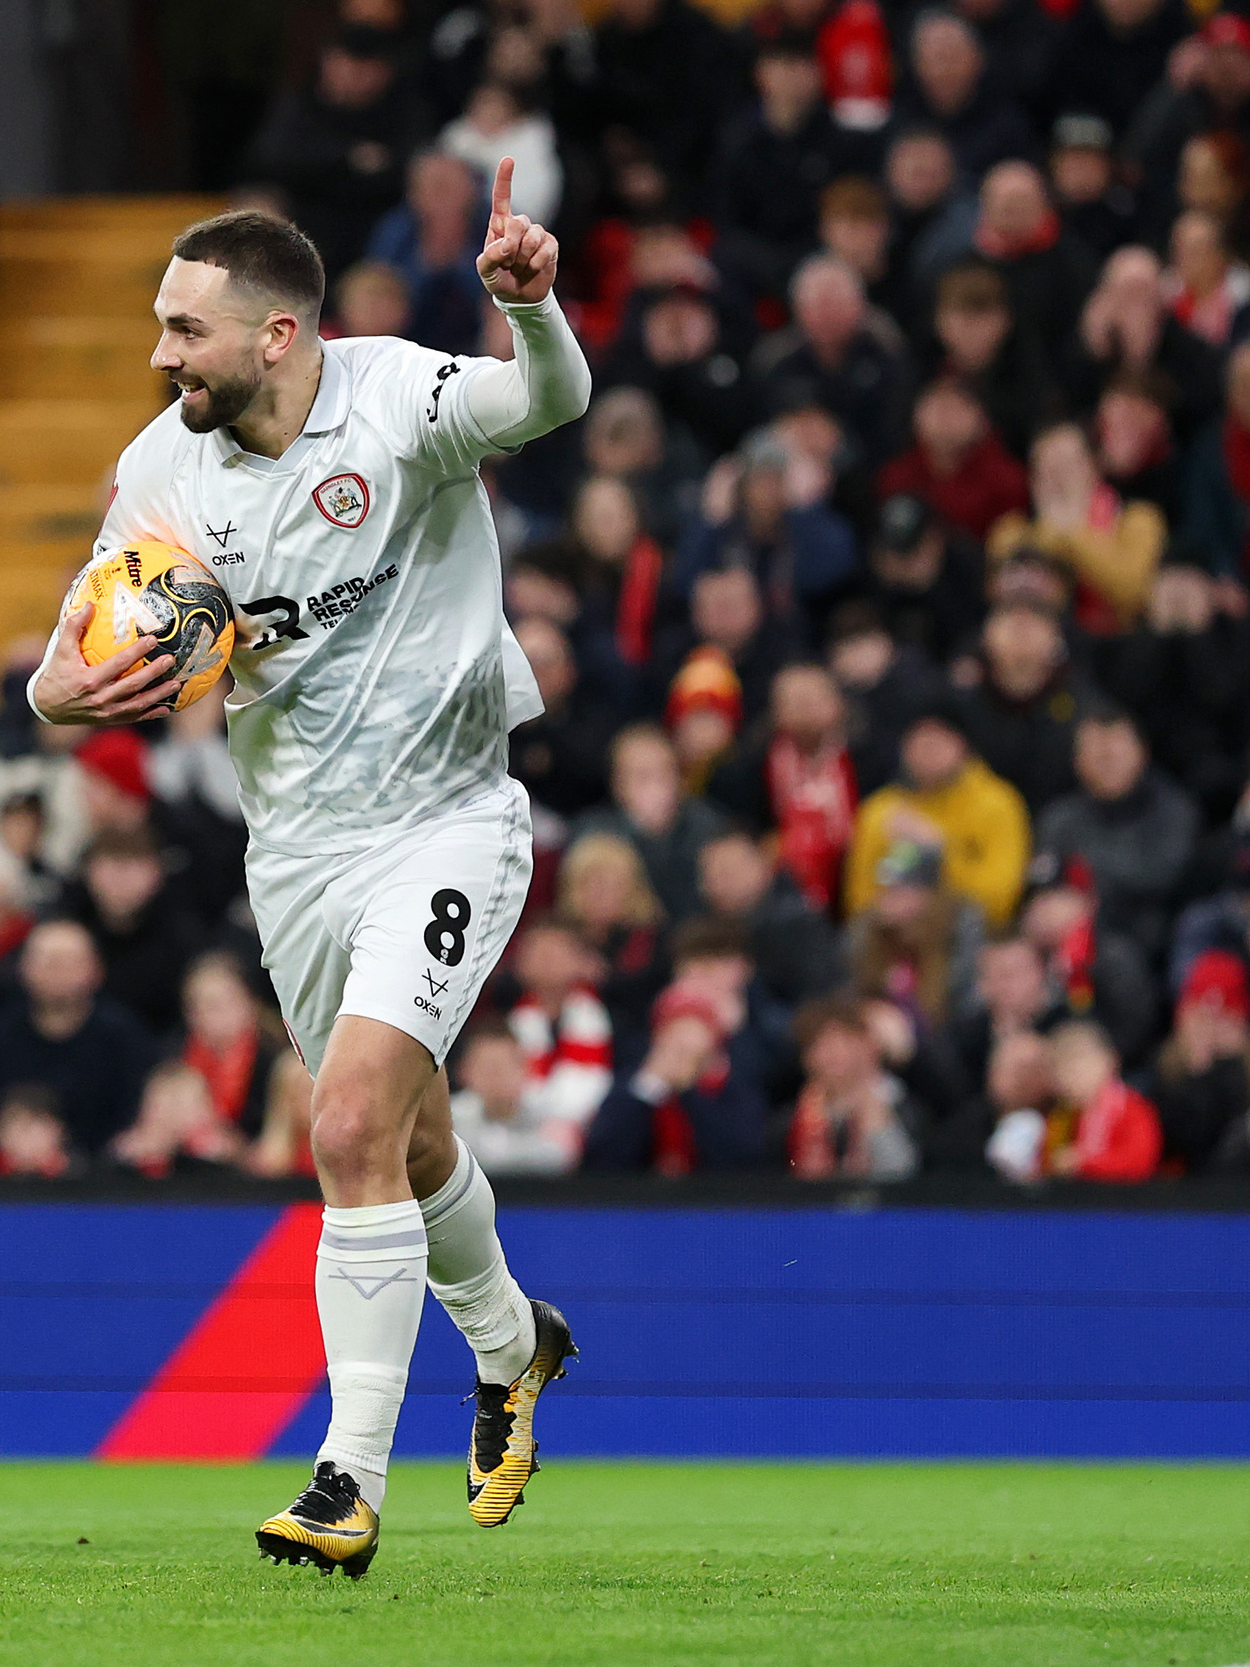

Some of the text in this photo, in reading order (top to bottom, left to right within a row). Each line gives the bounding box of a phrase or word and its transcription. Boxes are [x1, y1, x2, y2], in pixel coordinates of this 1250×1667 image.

[123, 550, 142, 588] Mitre
[212, 551, 245, 566] OXEN
[306, 577, 365, 612] RAPID
[423, 888, 471, 967] 8
[413, 996, 442, 1021] OXEN
